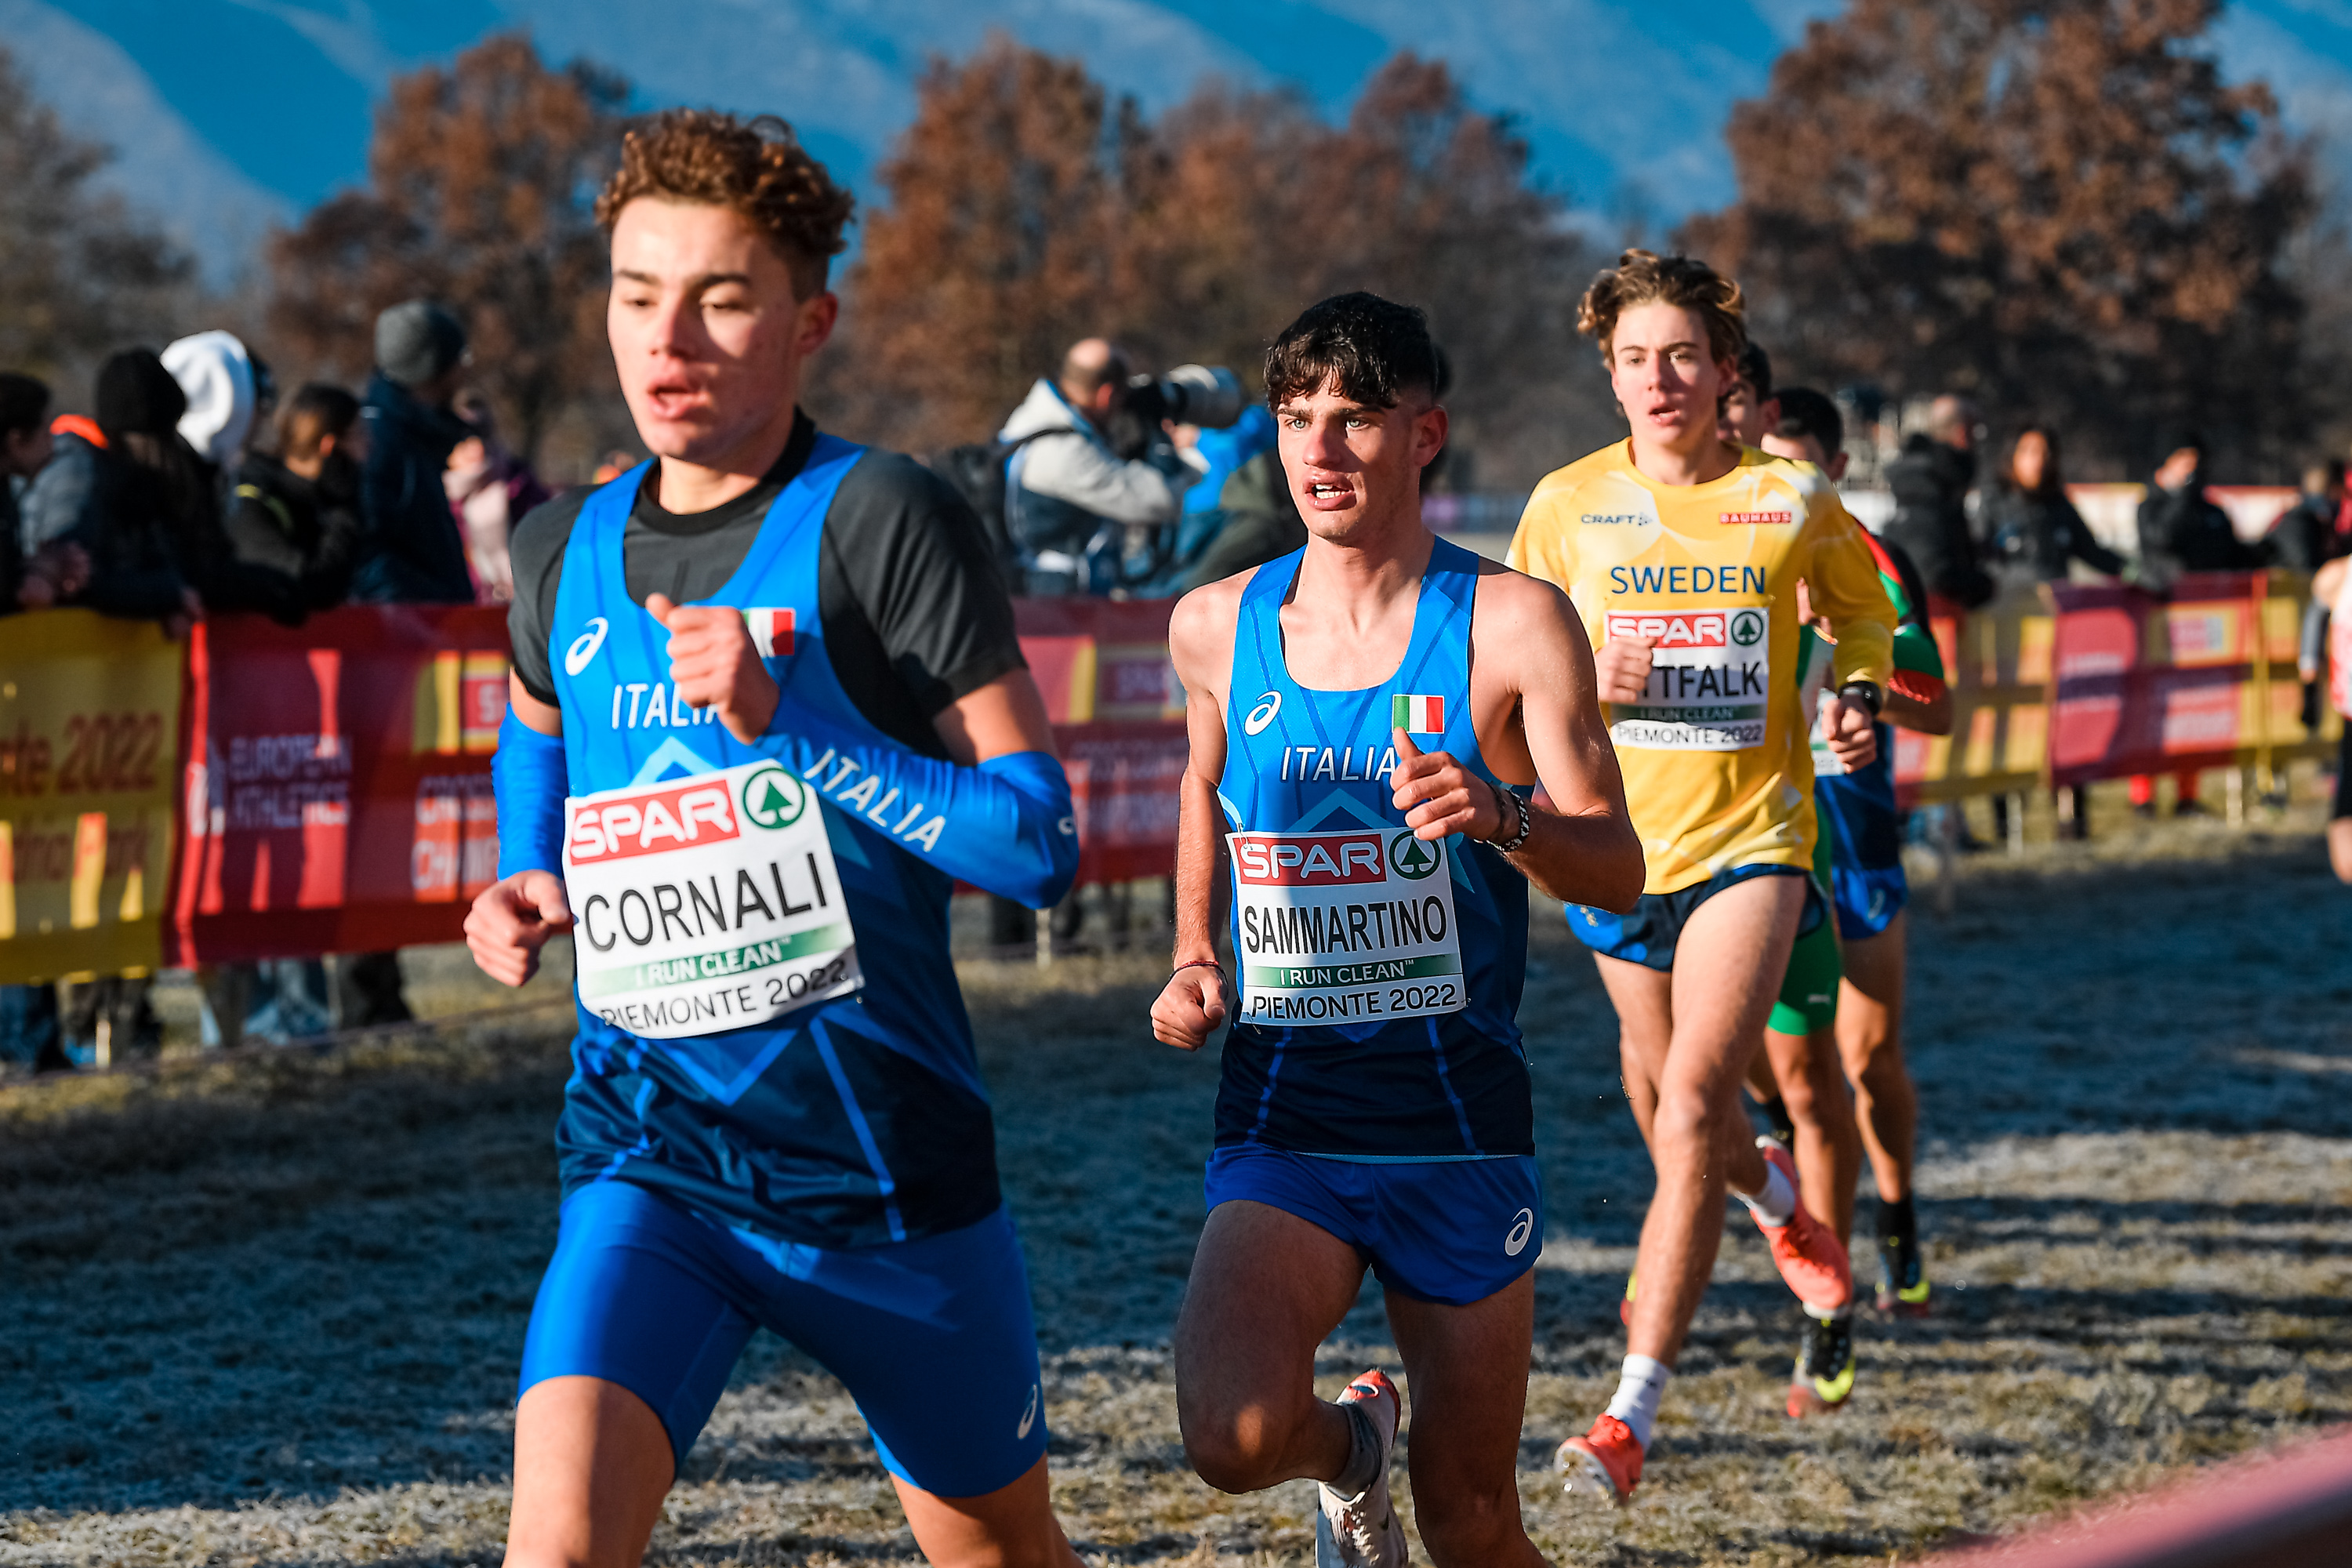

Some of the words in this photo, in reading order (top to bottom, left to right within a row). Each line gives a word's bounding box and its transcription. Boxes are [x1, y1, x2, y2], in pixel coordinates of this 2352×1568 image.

[1581, 514, 1635, 524] CRAFT
[1719, 511, 1791, 524] BAUHAUS
[1610, 566, 1765, 594] SWEDEN
[1610, 616, 1725, 644] SPAR
[59, 712, 162, 790] 2022
[1617, 725, 1714, 743] PIEMONTE
[1721, 724, 1762, 742] 2022
[1280, 746, 1399, 782] ITALIA
[804, 749, 946, 853] ITALIA
[571, 787, 735, 858] SPAR
[1240, 840, 1381, 880] SPAR
[584, 852, 828, 953] CORNALI
[1245, 895, 1447, 954] SAMMARTINO
[635, 966, 644, 987] I
[648, 957, 699, 985] RUN
[1280, 969, 1286, 985] I
[1290, 968, 1331, 986] RUN
[601, 985, 757, 1029] PIEMONTE
[765, 958, 848, 1005] 2022
[1253, 991, 1383, 1020] PIEMONTE
[1389, 983, 1457, 1012] 2022
